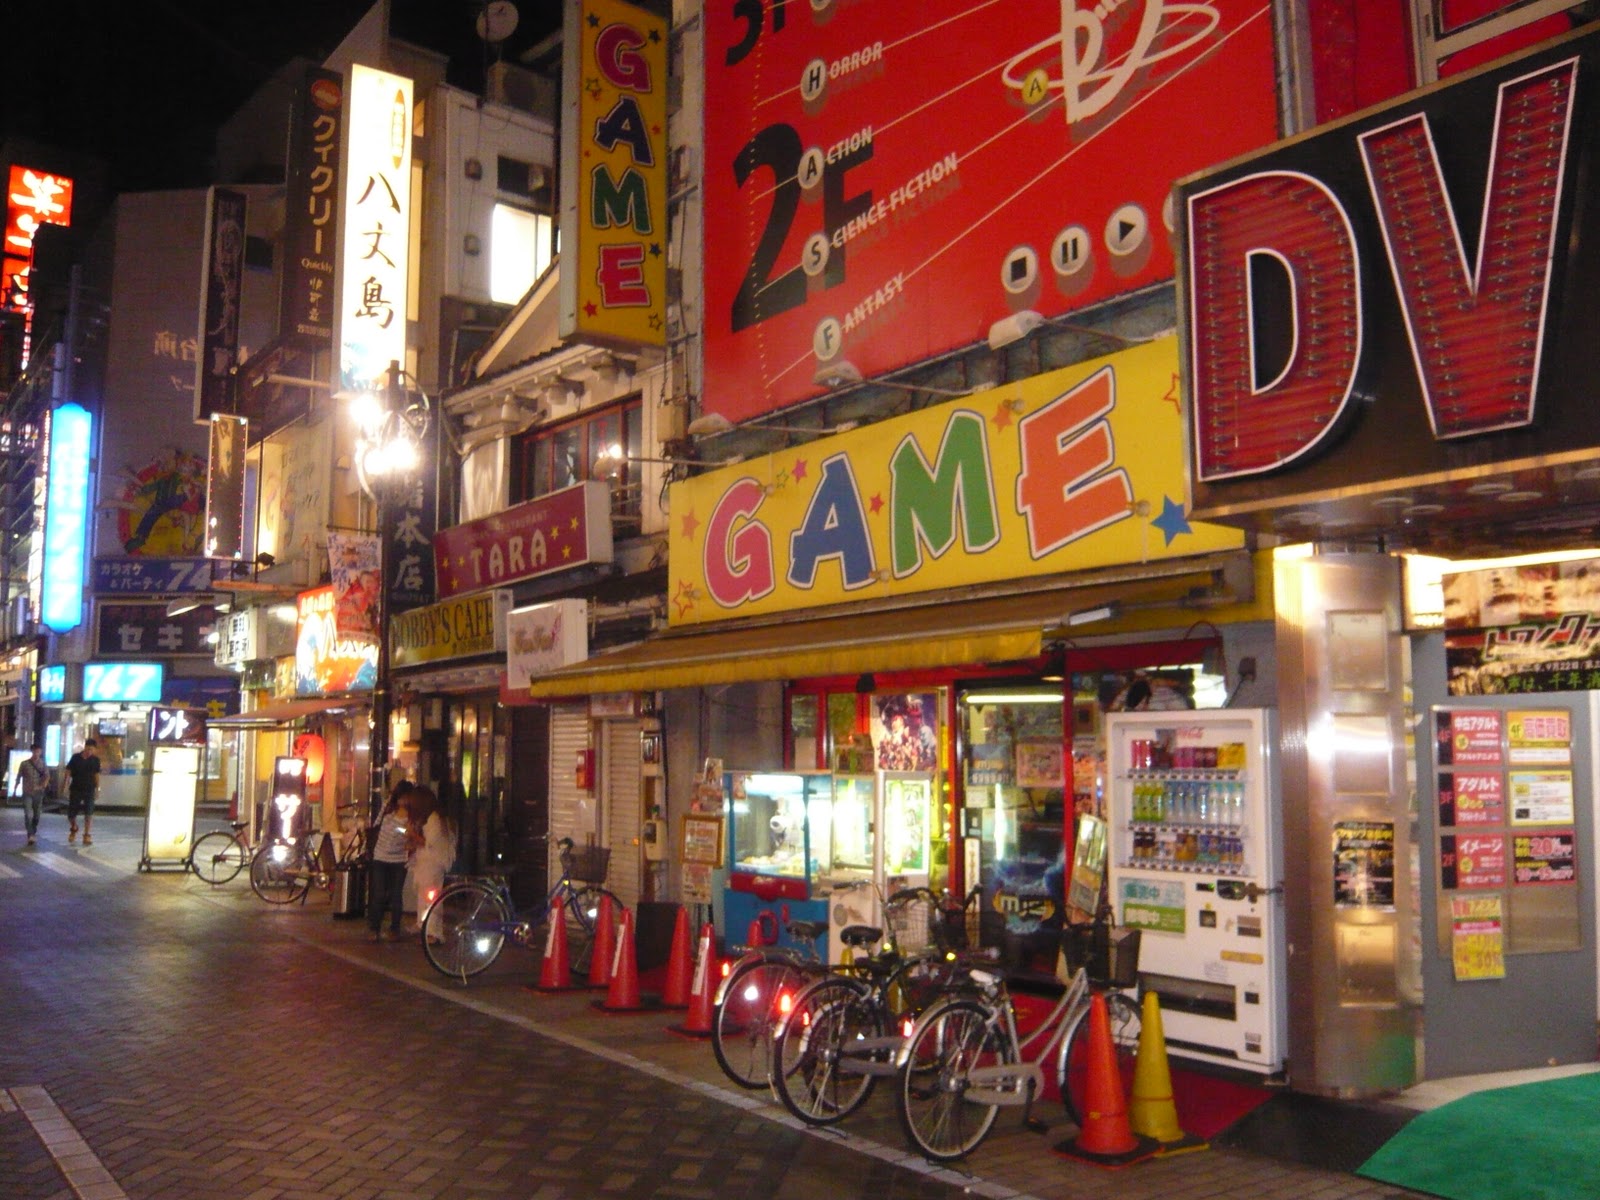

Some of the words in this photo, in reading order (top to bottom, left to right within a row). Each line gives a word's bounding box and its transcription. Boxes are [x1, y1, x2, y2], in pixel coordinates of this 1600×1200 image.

[808, 41, 883, 93] HORROR
[593, 22, 654, 308] GAME
[805, 126, 873, 178] ACTION
[731, 122, 873, 334] 2F
[810, 199, 886, 268] SCIENCE
[890, 152, 958, 211] FICTION
[355, 171, 401, 330] 八丈島
[823, 273, 905, 351] FANTASY
[703, 364, 1136, 608] GAME
[470, 529, 548, 583] TARA
[453, 596, 494, 640] CAFE
[1457, 776, 1500, 791] アダルト
[1442, 854, 1455, 867] 2F
[1459, 838, 1503, 854] イメージ
